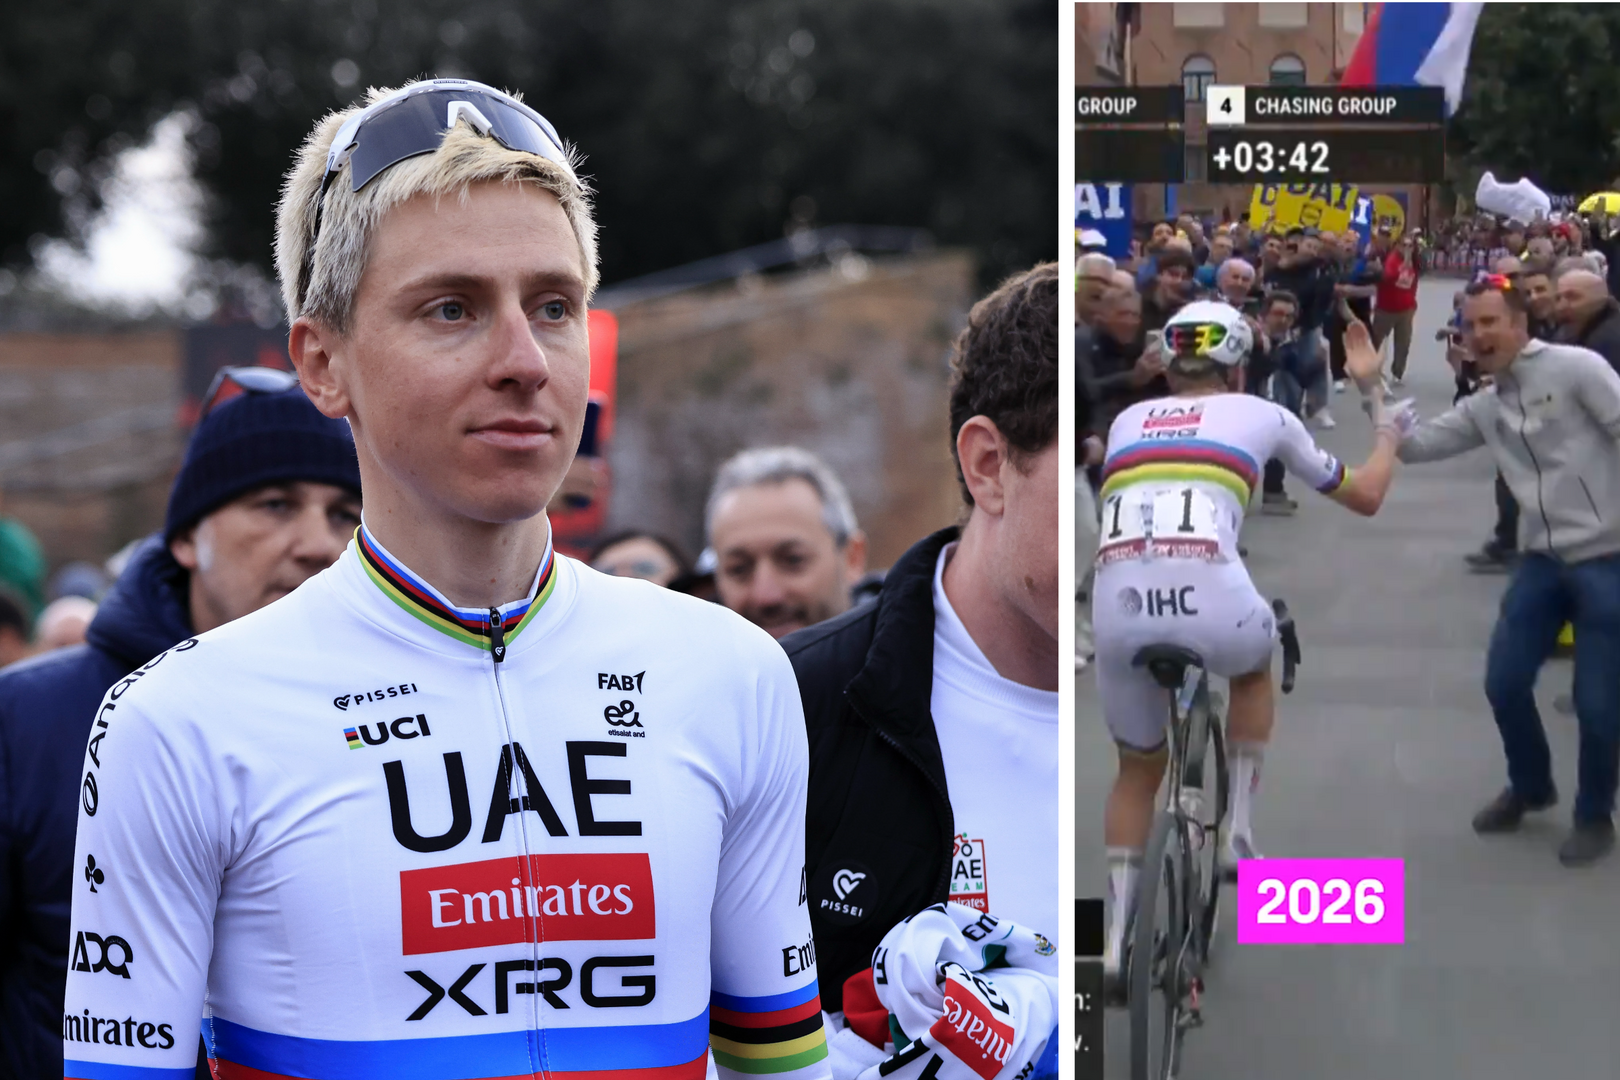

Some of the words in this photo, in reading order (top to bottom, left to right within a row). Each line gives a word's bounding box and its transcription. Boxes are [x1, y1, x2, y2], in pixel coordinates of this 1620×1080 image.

[1107, 495, 1122, 540] 1
[1177, 487, 1195, 533] 1
[1146, 585, 1199, 616] IHC
[353, 682, 418, 706] PISSEI
[358, 713, 432, 746] UCI
[607, 728, 632, 738] etisalat
[632, 730, 646, 738] and
[382, 740, 643, 853] UAE
[951, 881, 983, 892] EAM
[953, 858, 982, 880] AE
[427, 876, 635, 929] Emirates
[820, 899, 864, 918] PISSEI
[71, 931, 134, 980] ADQ
[781, 932, 817, 978] Emi
[403, 954, 657, 1022] XRG
[63, 1008, 175, 1050] mirates
